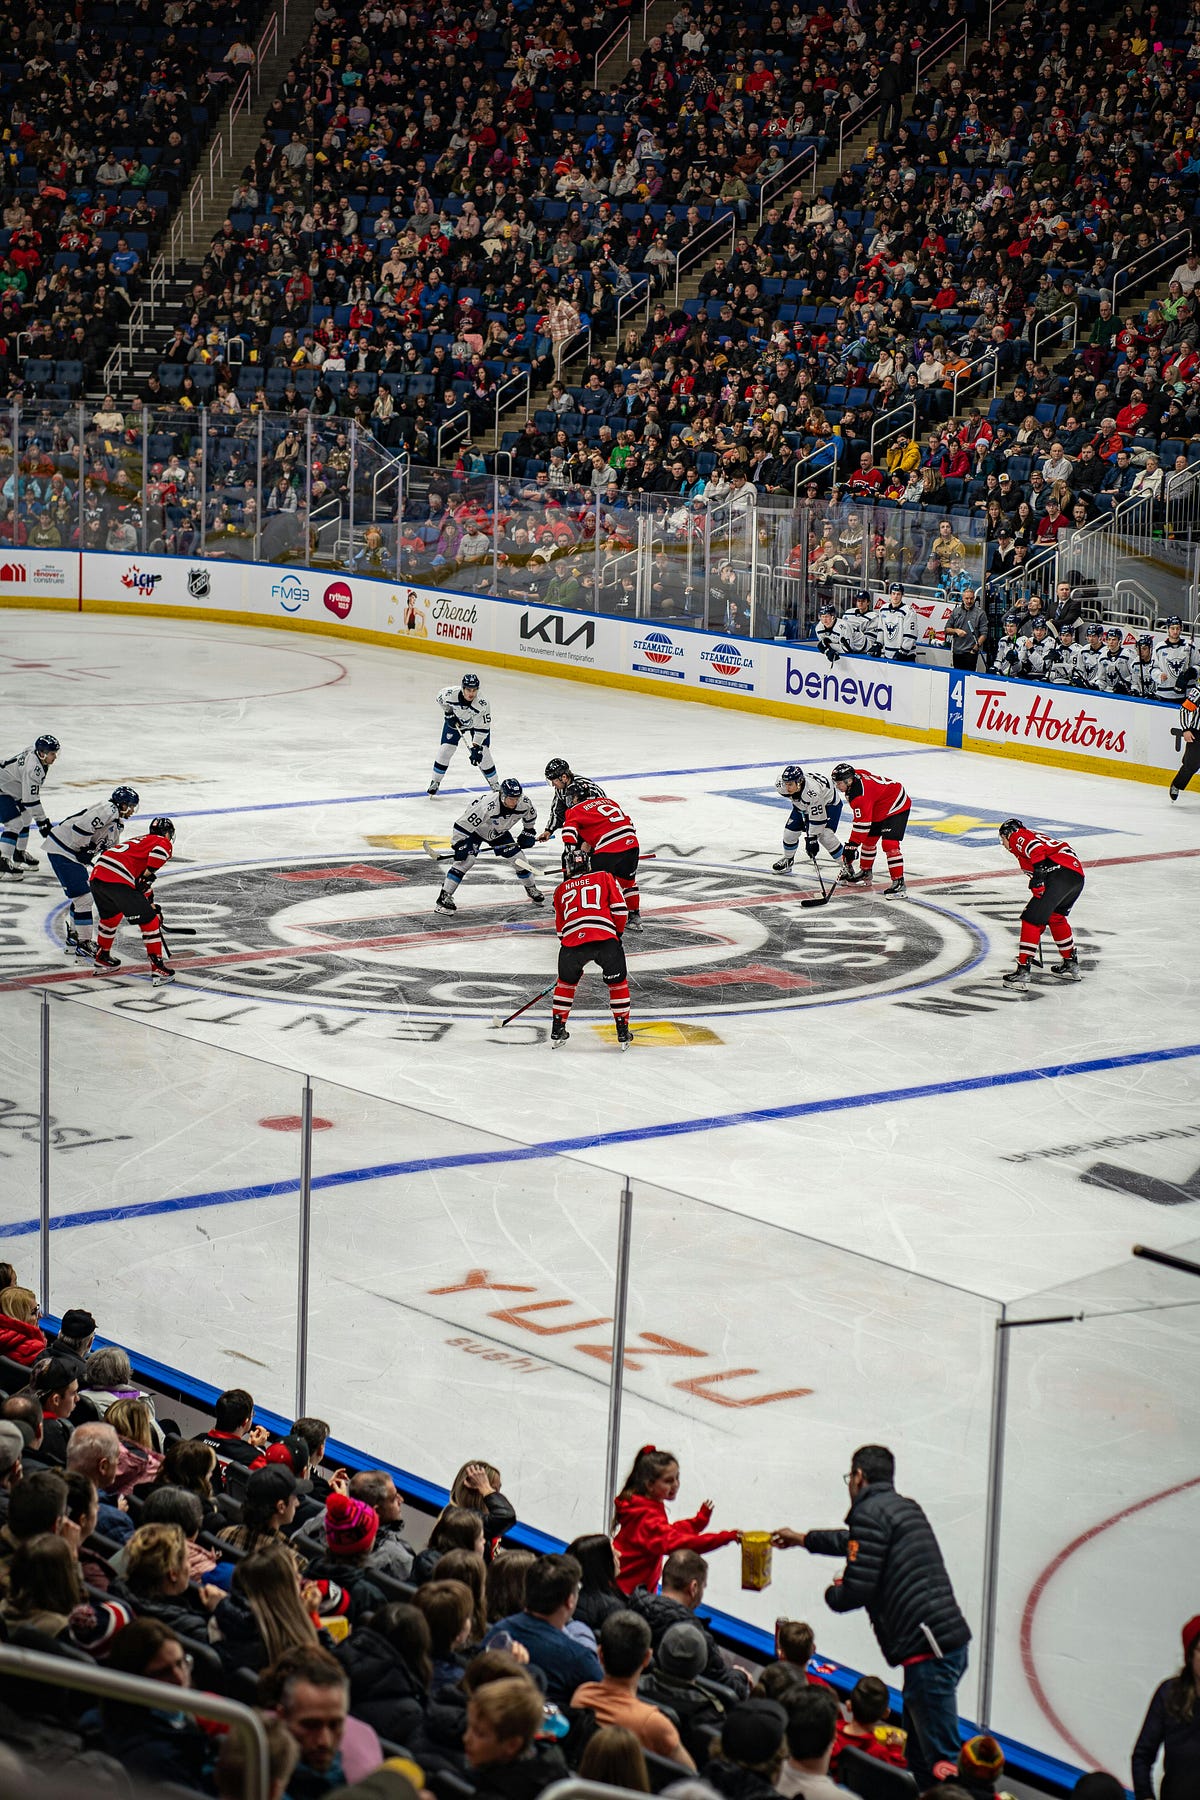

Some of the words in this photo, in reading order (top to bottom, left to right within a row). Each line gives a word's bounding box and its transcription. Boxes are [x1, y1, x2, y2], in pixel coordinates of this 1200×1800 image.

[133, 573, 155, 588] LCH
[138, 587, 153, 596] TV
[272, 585, 310, 602] FM93
[432, 599, 478, 624] French
[436, 622, 473, 641] CANCAN
[519, 643, 527, 652] Du
[527, 646, 556, 656] mouvement
[556, 650, 567, 659] vient
[567, 652, 595, 663] l'inspiration
[633, 640, 684, 656] STEAMATIC.CA
[700, 651, 753, 668] STEAMATIC.CA
[785, 657, 893, 711] beneva
[951, 680, 963, 708] 4
[483, 714, 491, 724] 15
[976, 689, 1019, 735] Tim
[1025, 694, 1127, 753] Hortons
[31, 784, 40, 795] 21
[811, 804, 823, 816] 29
[467, 813, 483, 827] 89
[565, 878, 591, 890] HAUSE
[561, 883, 601, 921] 20
[427, 1268, 815, 1409] YUZU
[444, 1336, 551, 1374] sushi
